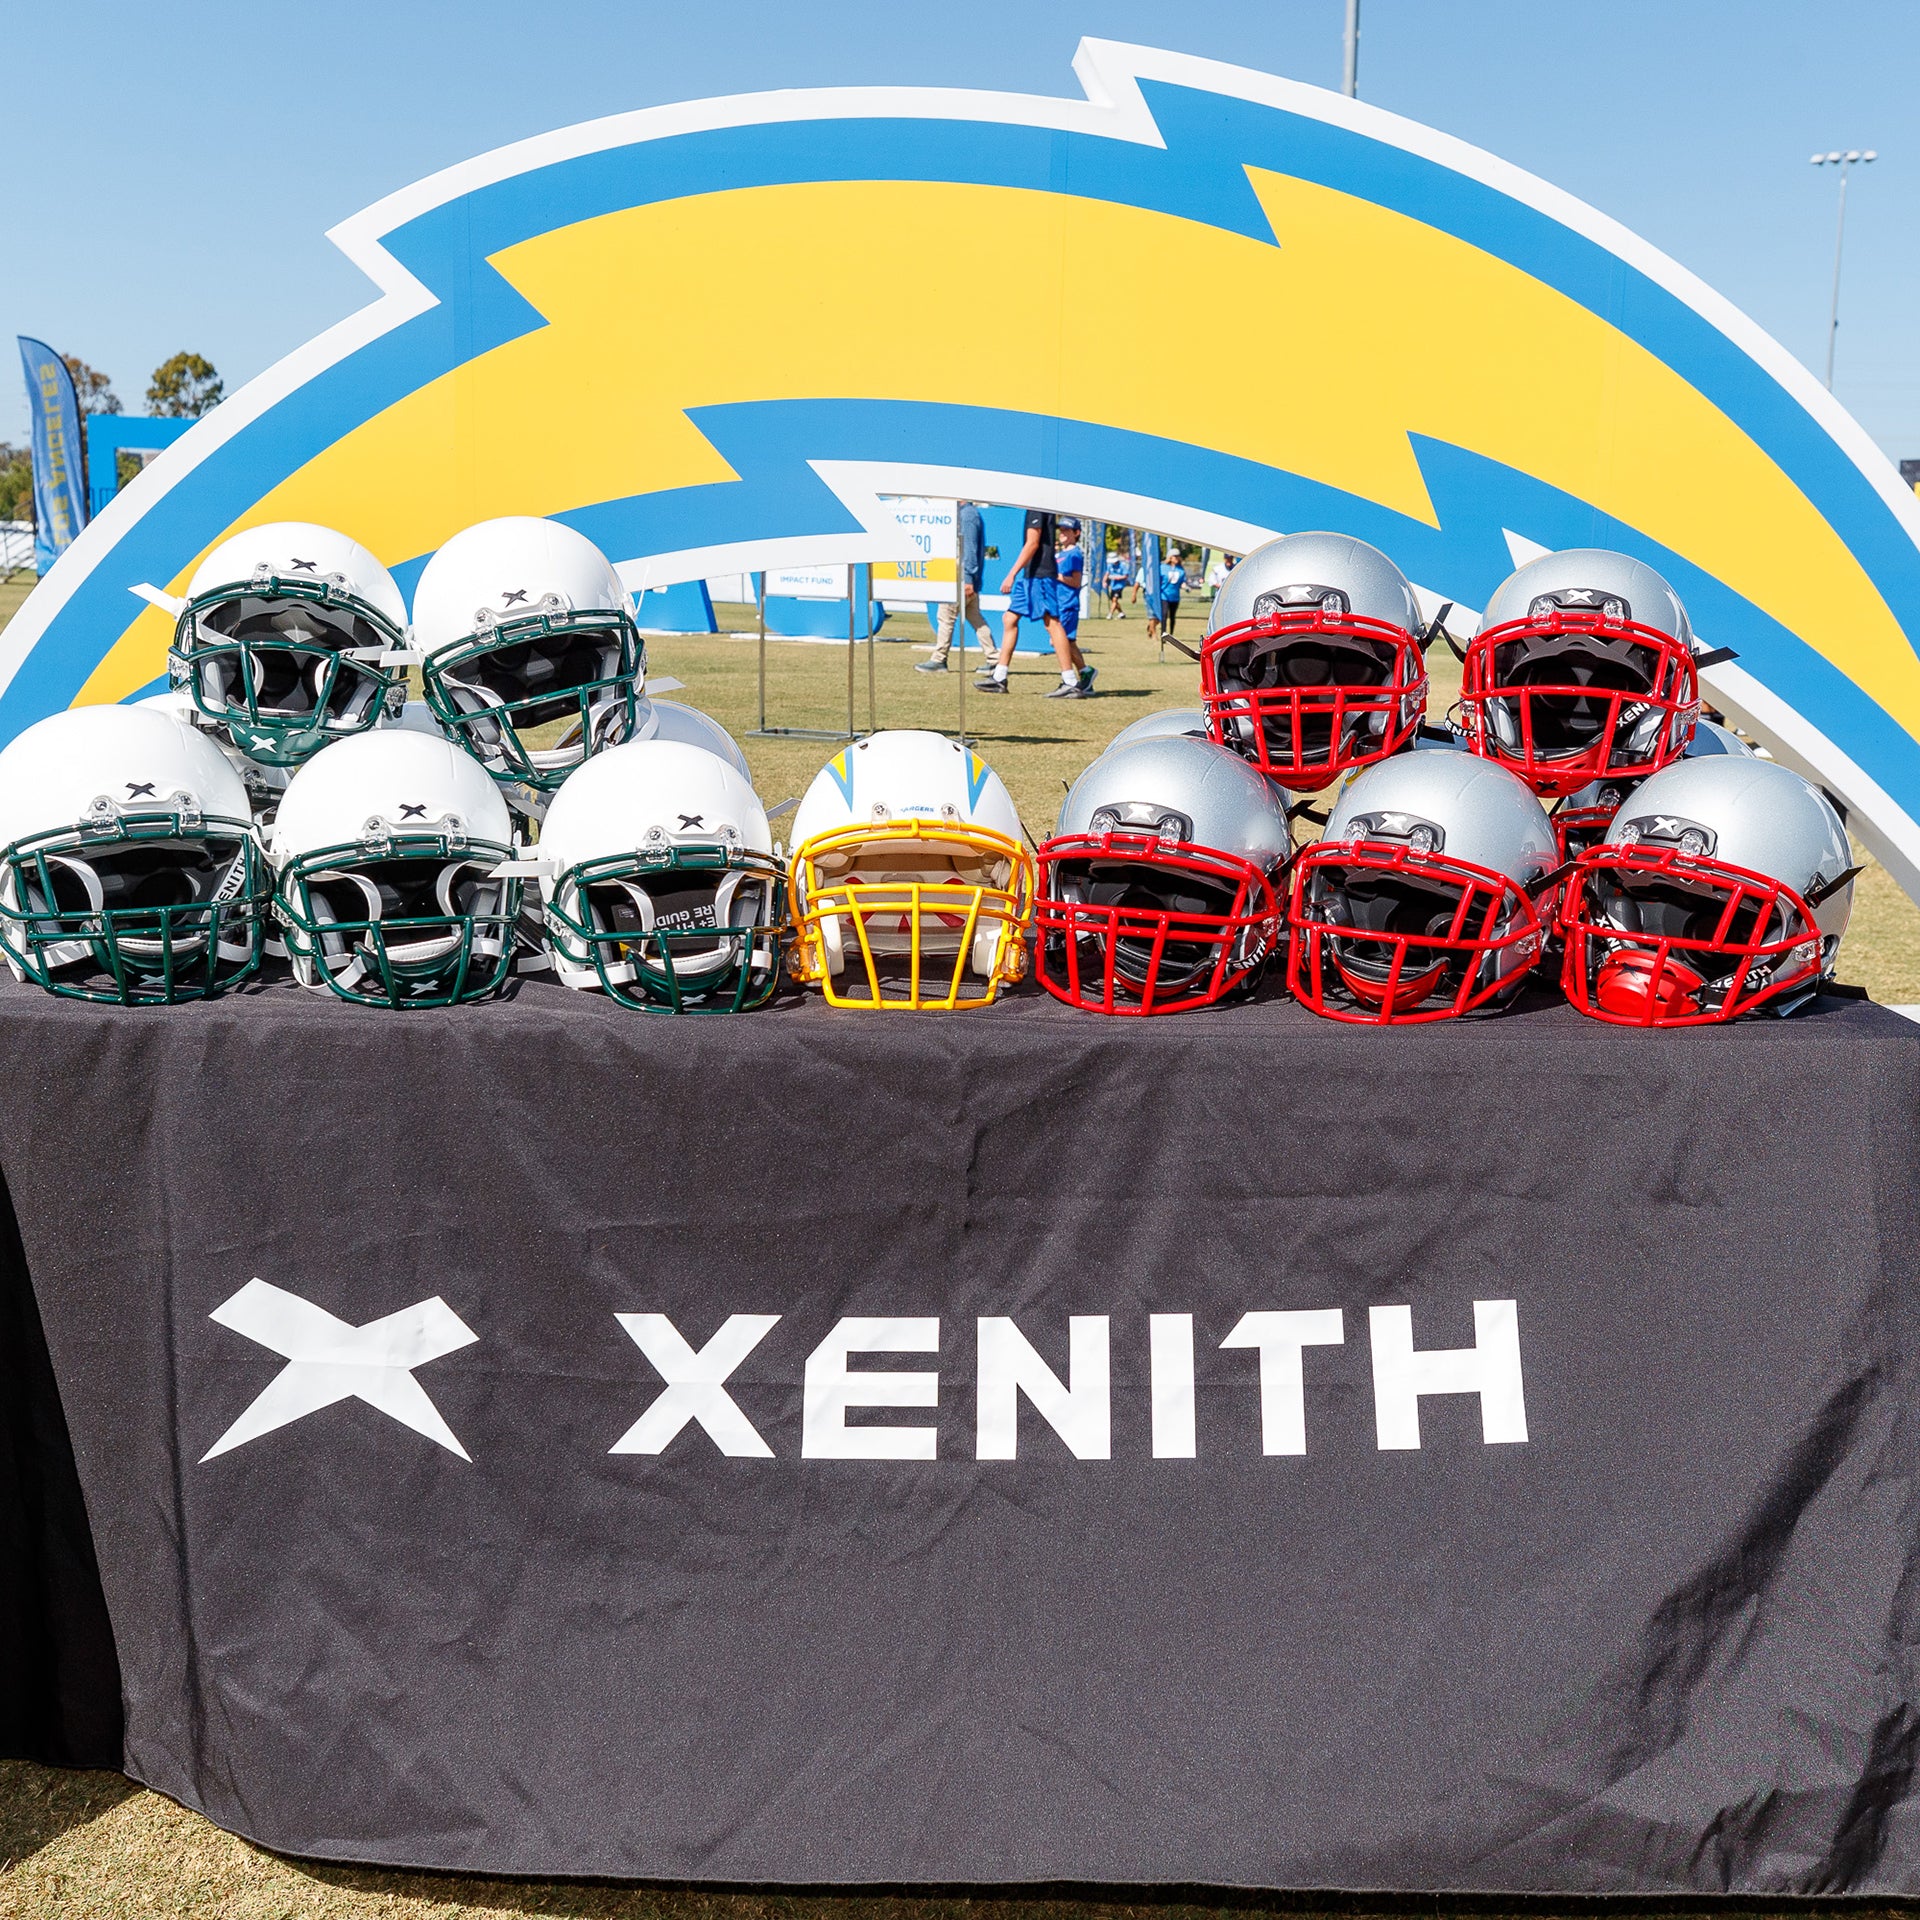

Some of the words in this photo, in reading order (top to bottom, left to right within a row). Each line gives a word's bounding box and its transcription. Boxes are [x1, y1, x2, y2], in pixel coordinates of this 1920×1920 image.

[895, 514, 917, 524] ACT
[920, 515, 952, 525] FUND
[897, 560, 928, 579] SALE
[780, 575, 809, 584] IMPACT
[811, 576, 834, 585] FUND
[218, 857, 246, 900] ENITH
[654, 909, 690, 928] GUID
[1232, 936, 1267, 970] ENITH
[608, 1299, 1530, 1462] XENITH
